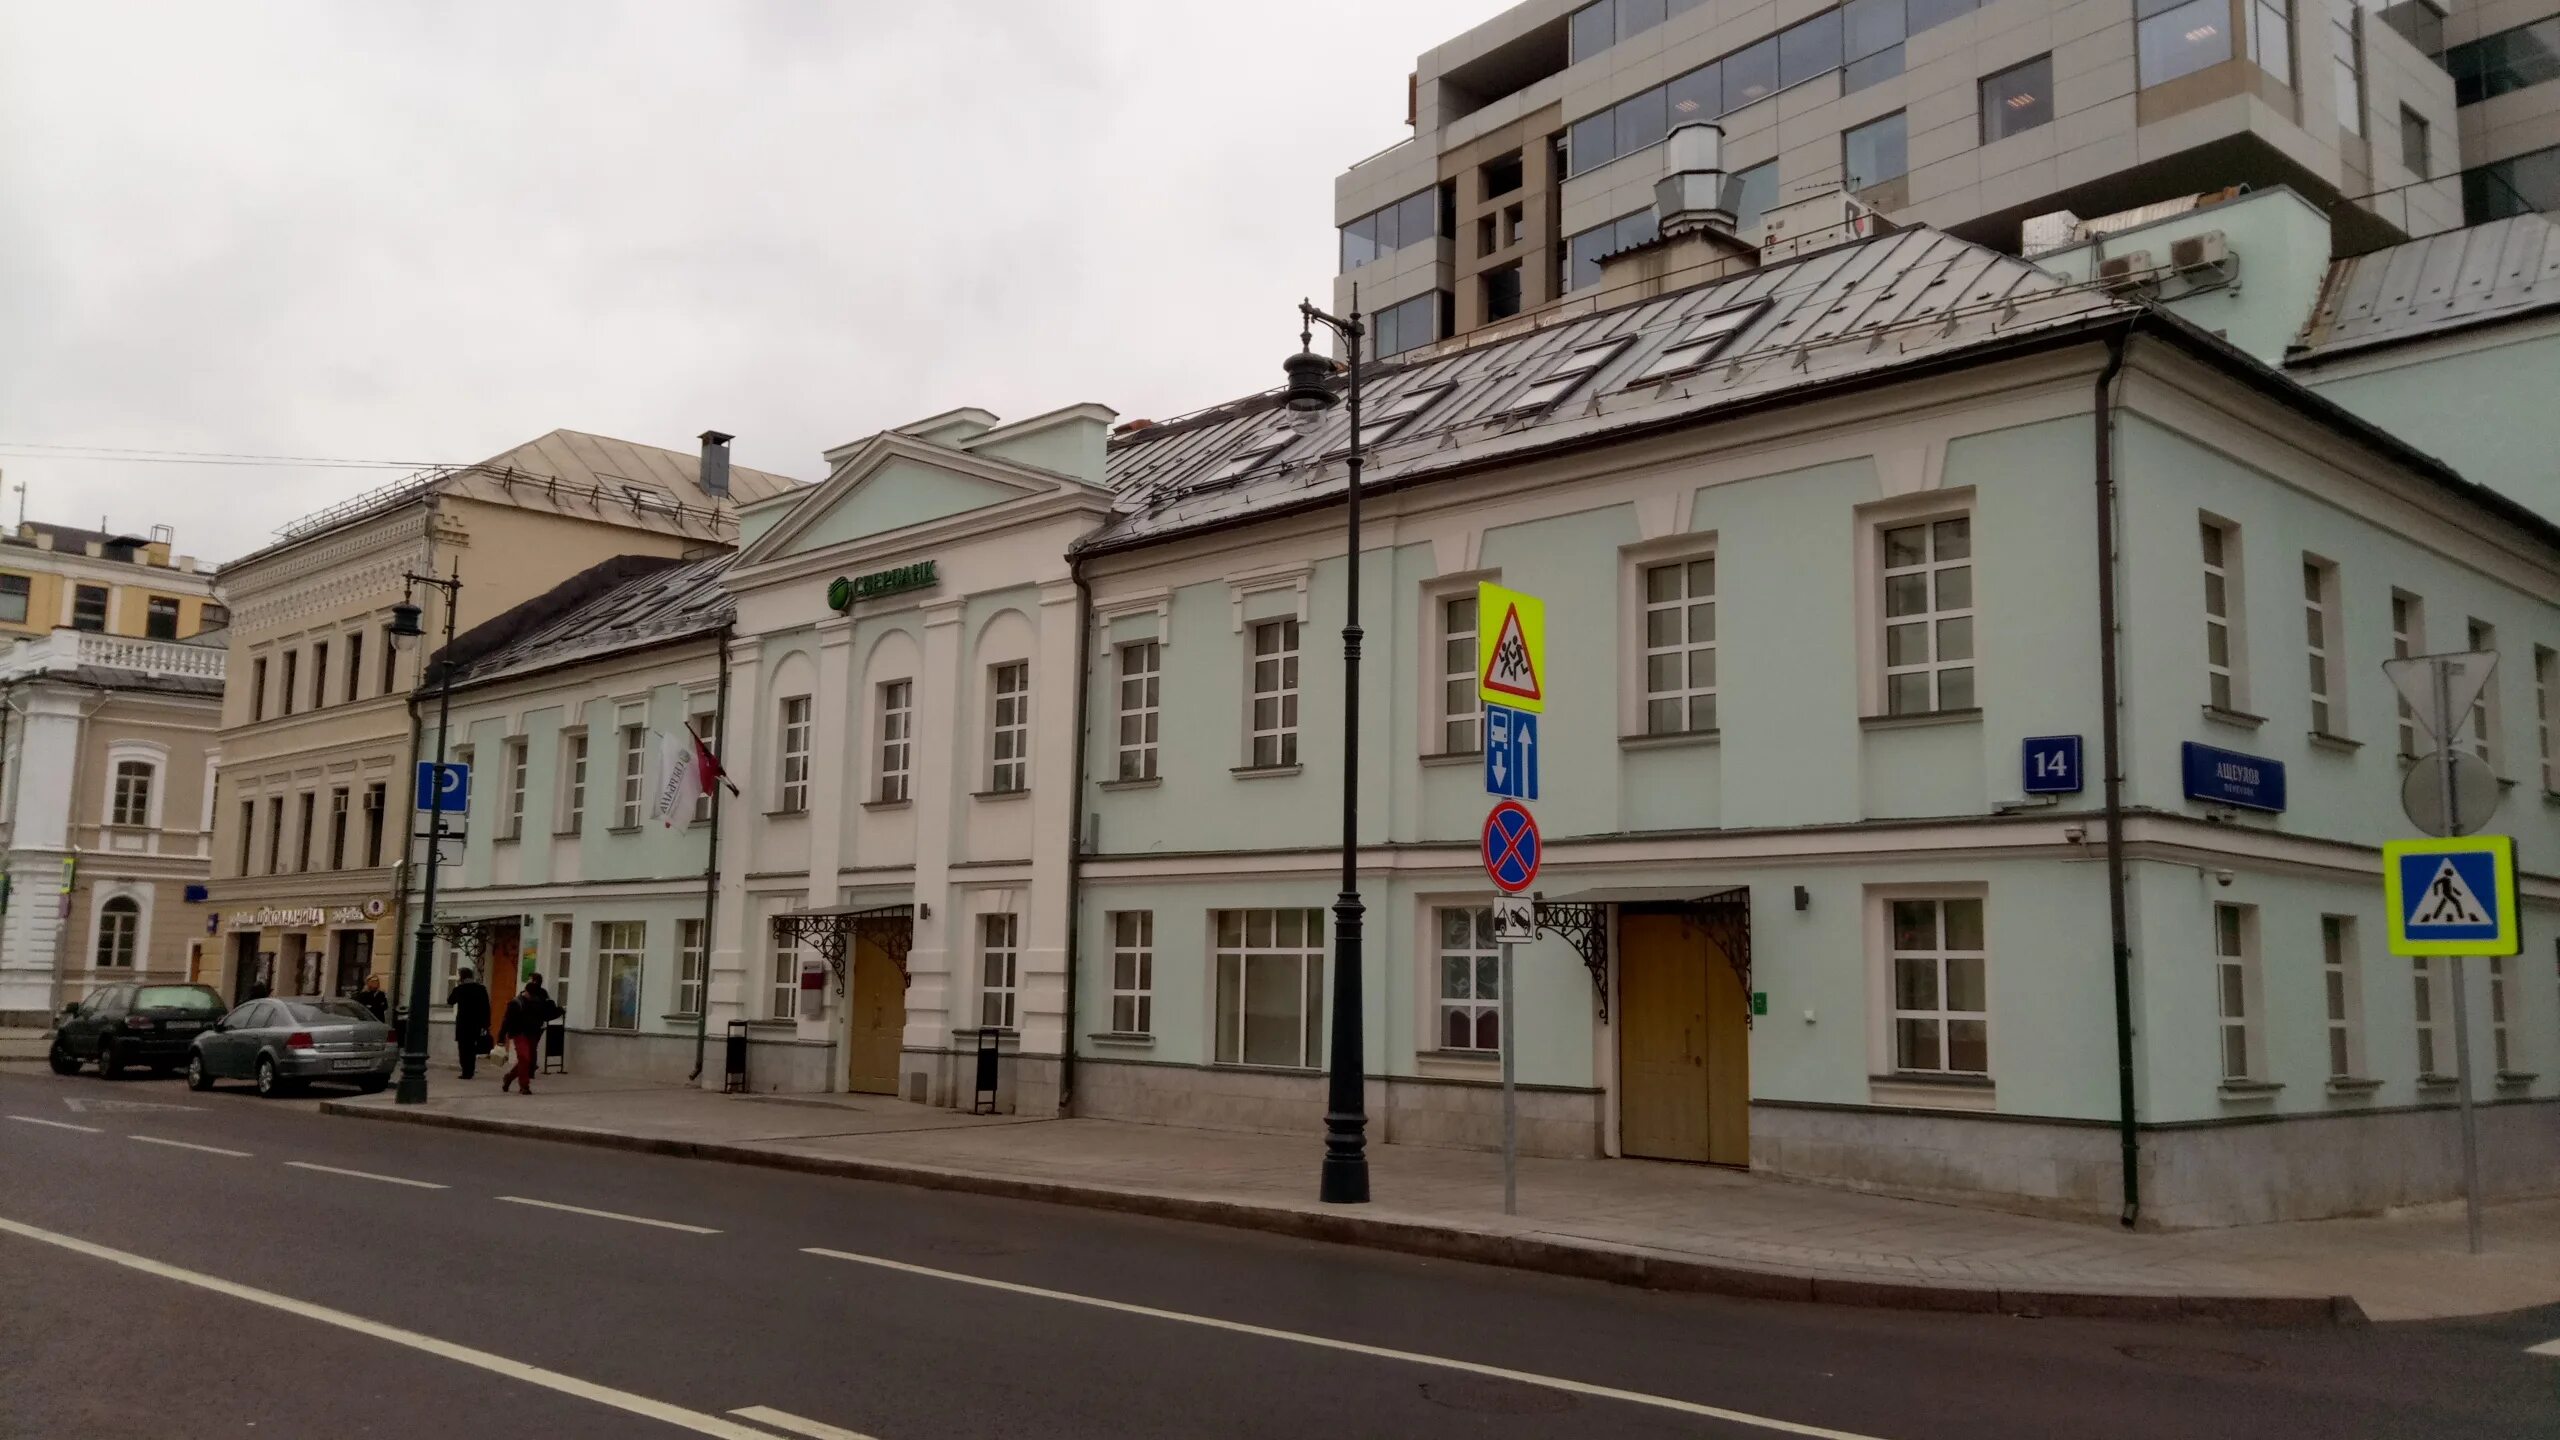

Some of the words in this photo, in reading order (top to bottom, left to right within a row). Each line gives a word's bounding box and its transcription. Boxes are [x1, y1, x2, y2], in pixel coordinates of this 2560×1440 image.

[854, 559, 936, 597] СБЕРБАНК
[2034, 750, 2067, 777] 14
[2217, 762, 2260, 785] АЩЕУЛОВ
